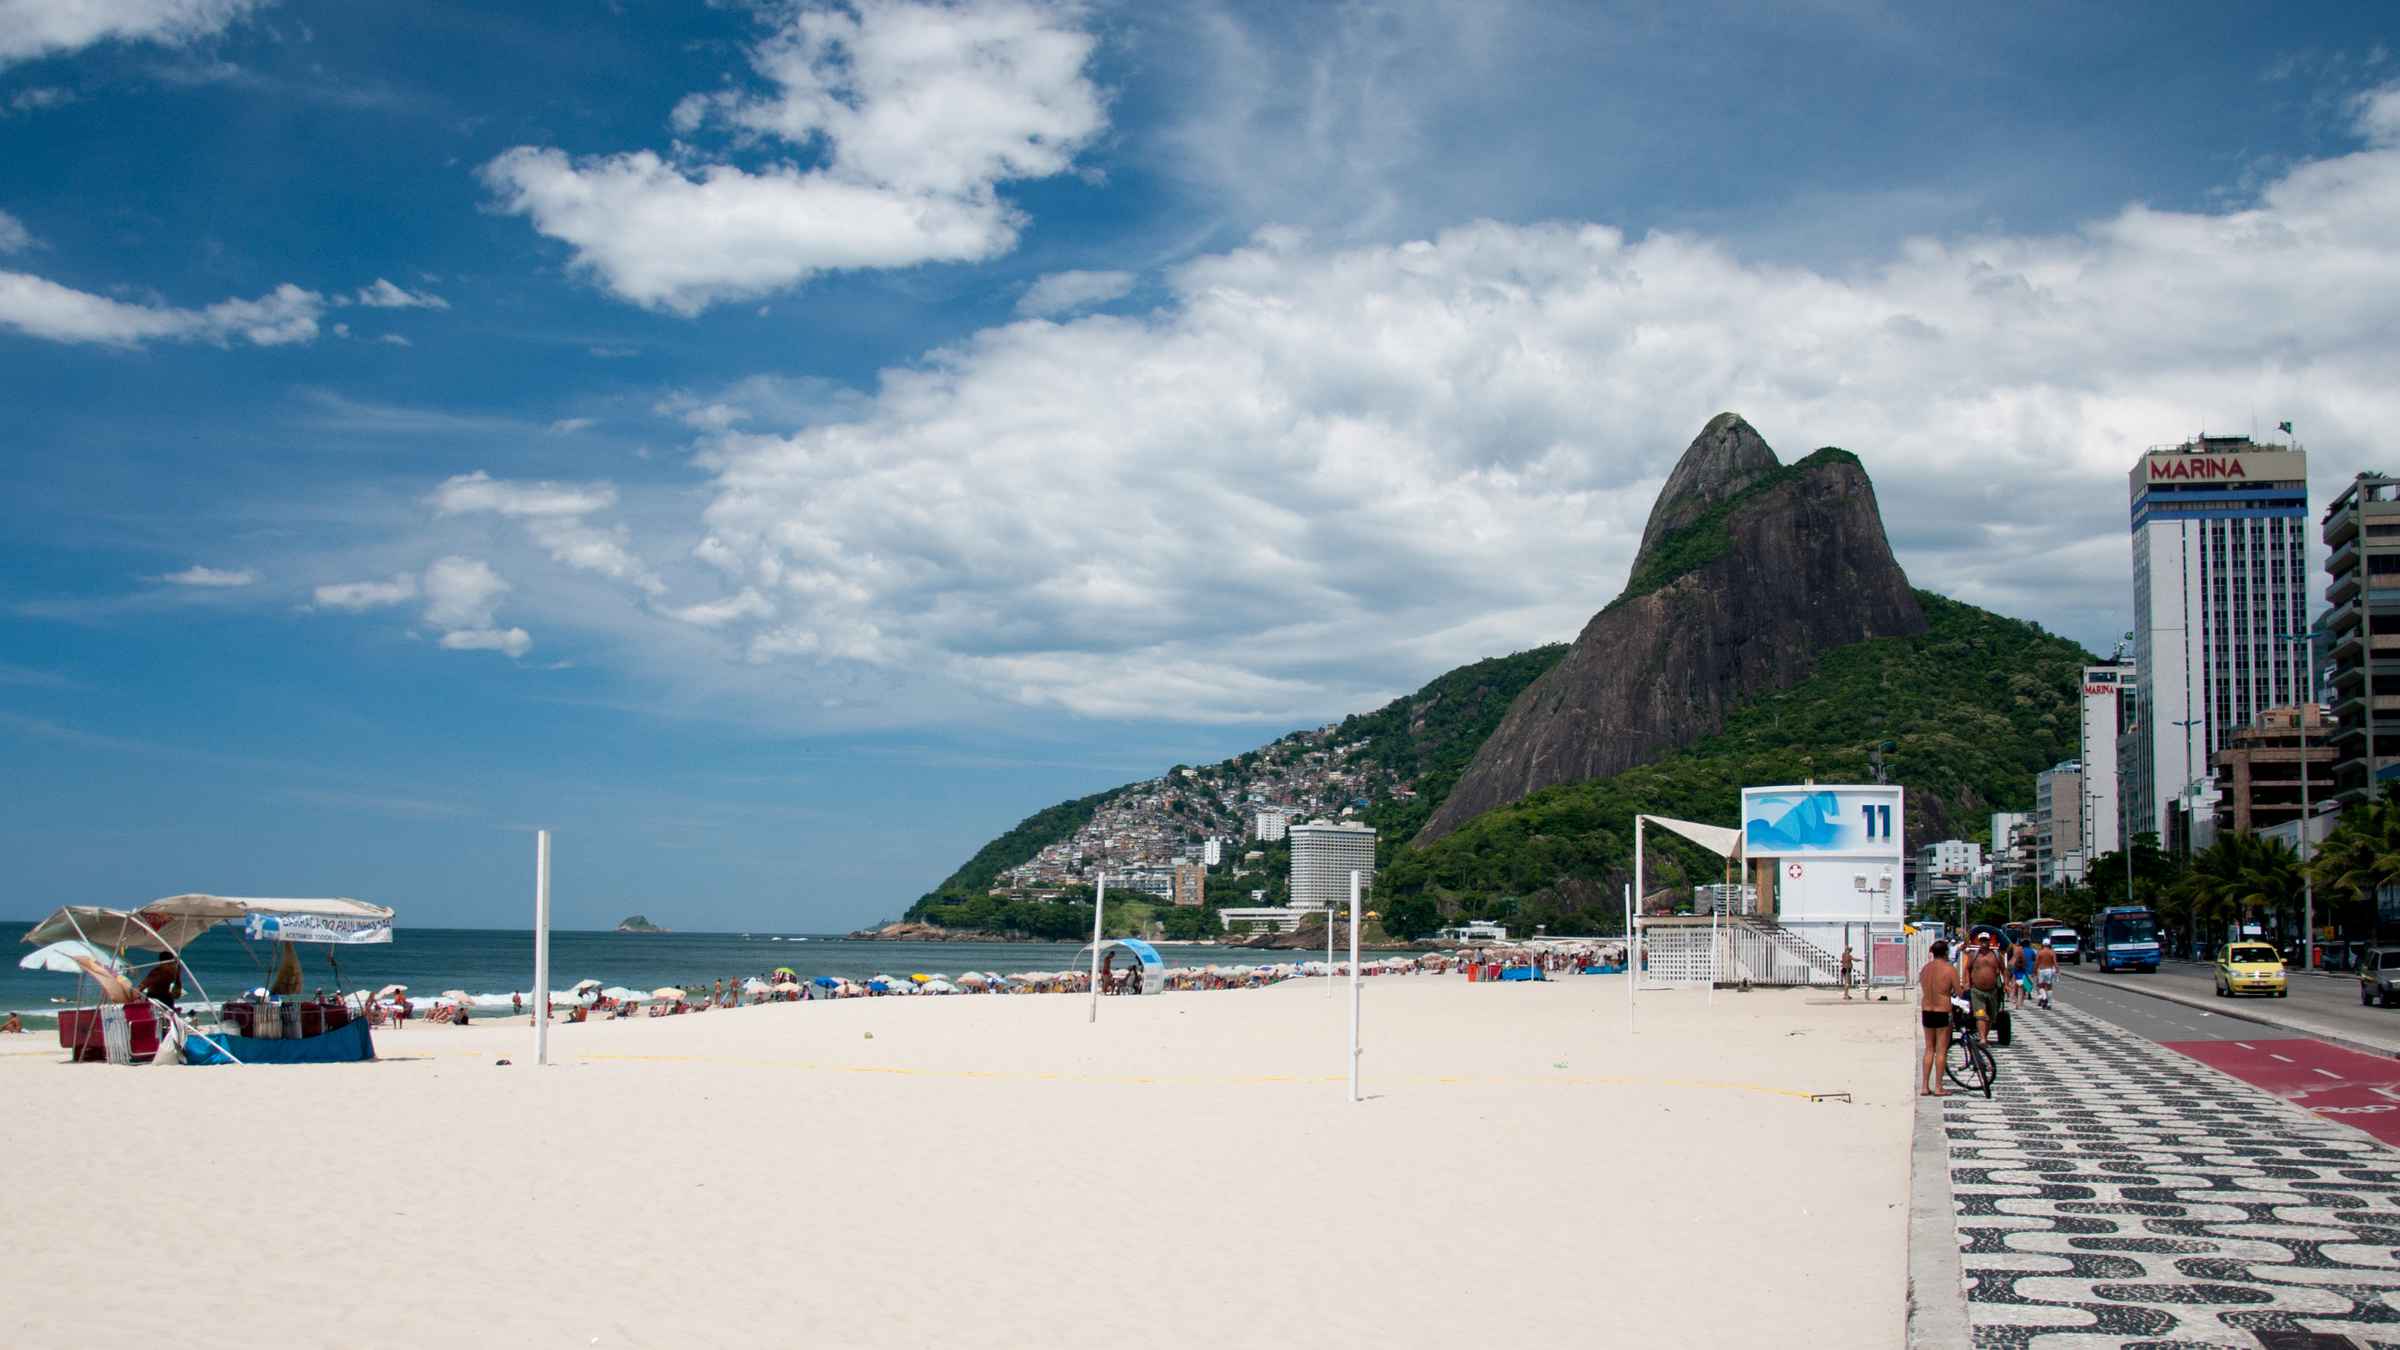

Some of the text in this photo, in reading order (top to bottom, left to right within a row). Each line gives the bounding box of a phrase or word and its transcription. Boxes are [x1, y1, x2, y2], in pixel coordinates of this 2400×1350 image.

[2150, 457, 2246, 479] MARINA
[2084, 683, 2114, 694] MARINA
[1862, 805, 1890, 838] 11
